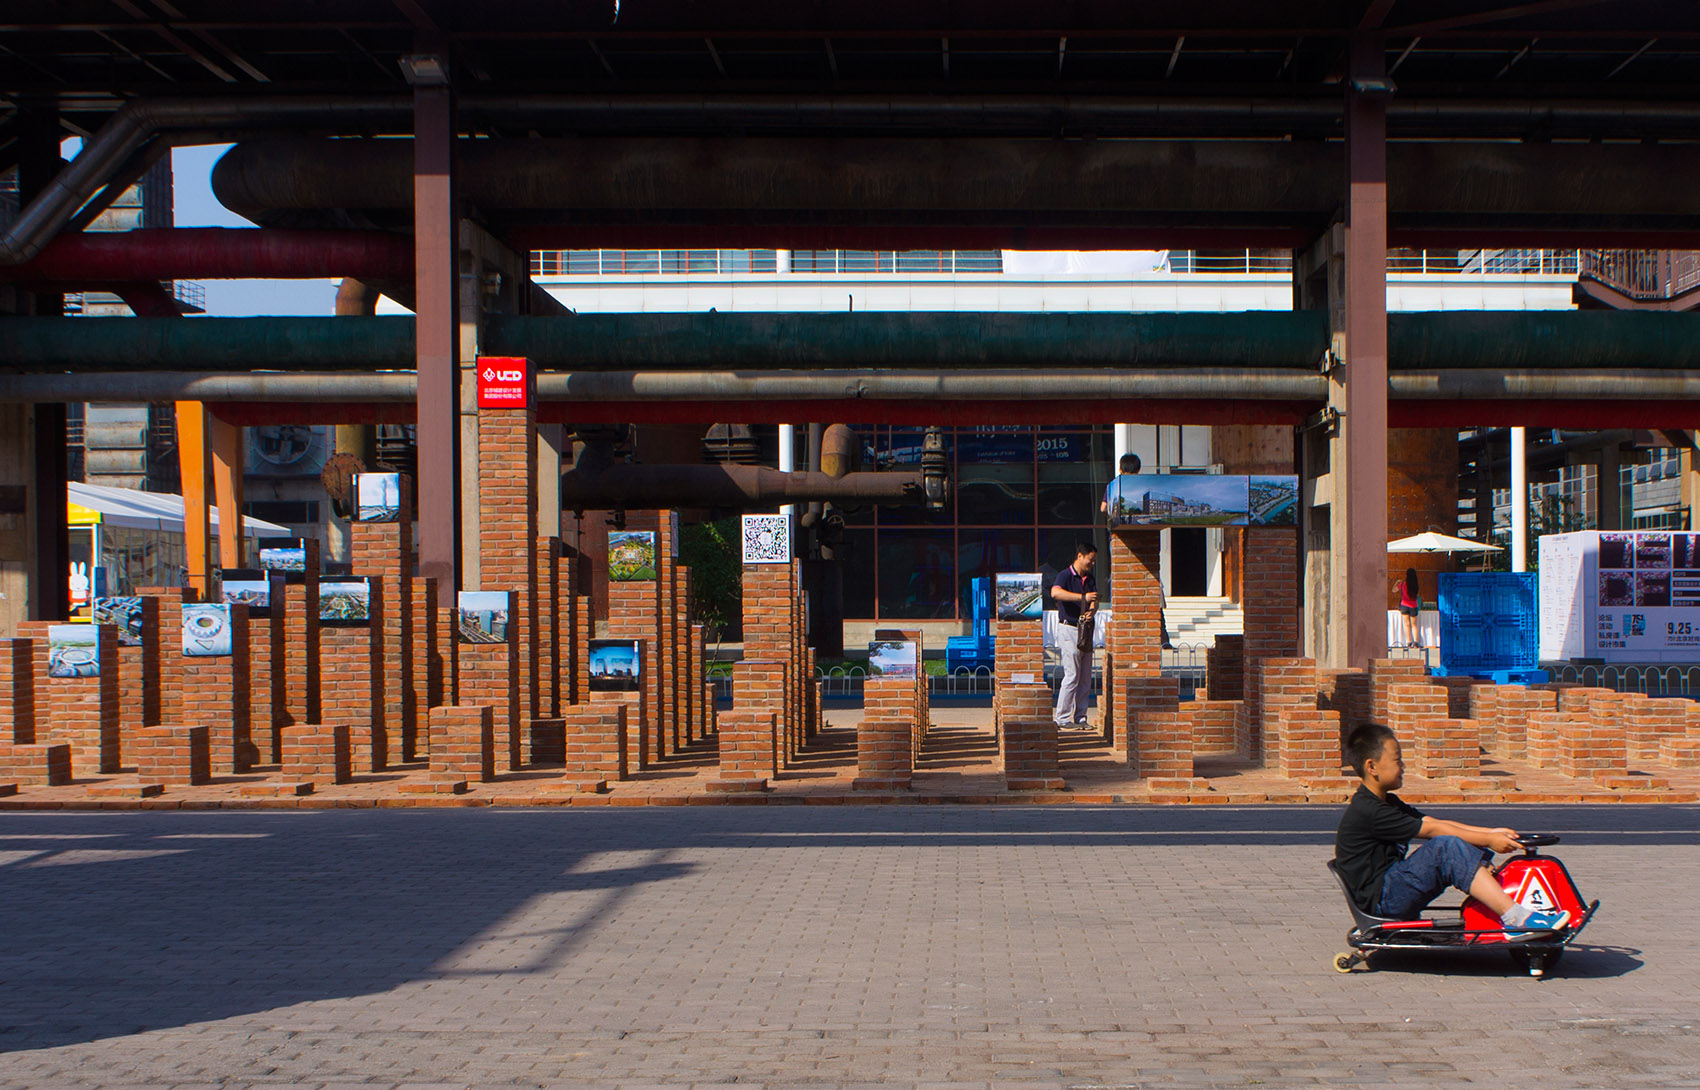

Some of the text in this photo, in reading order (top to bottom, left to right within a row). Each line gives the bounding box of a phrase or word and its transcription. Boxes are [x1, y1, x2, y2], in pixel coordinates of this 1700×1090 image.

[496, 370, 523, 382] UCD
[1036, 437, 1069, 451] 2015
[1667, 622, 1692, 635] 9.25
